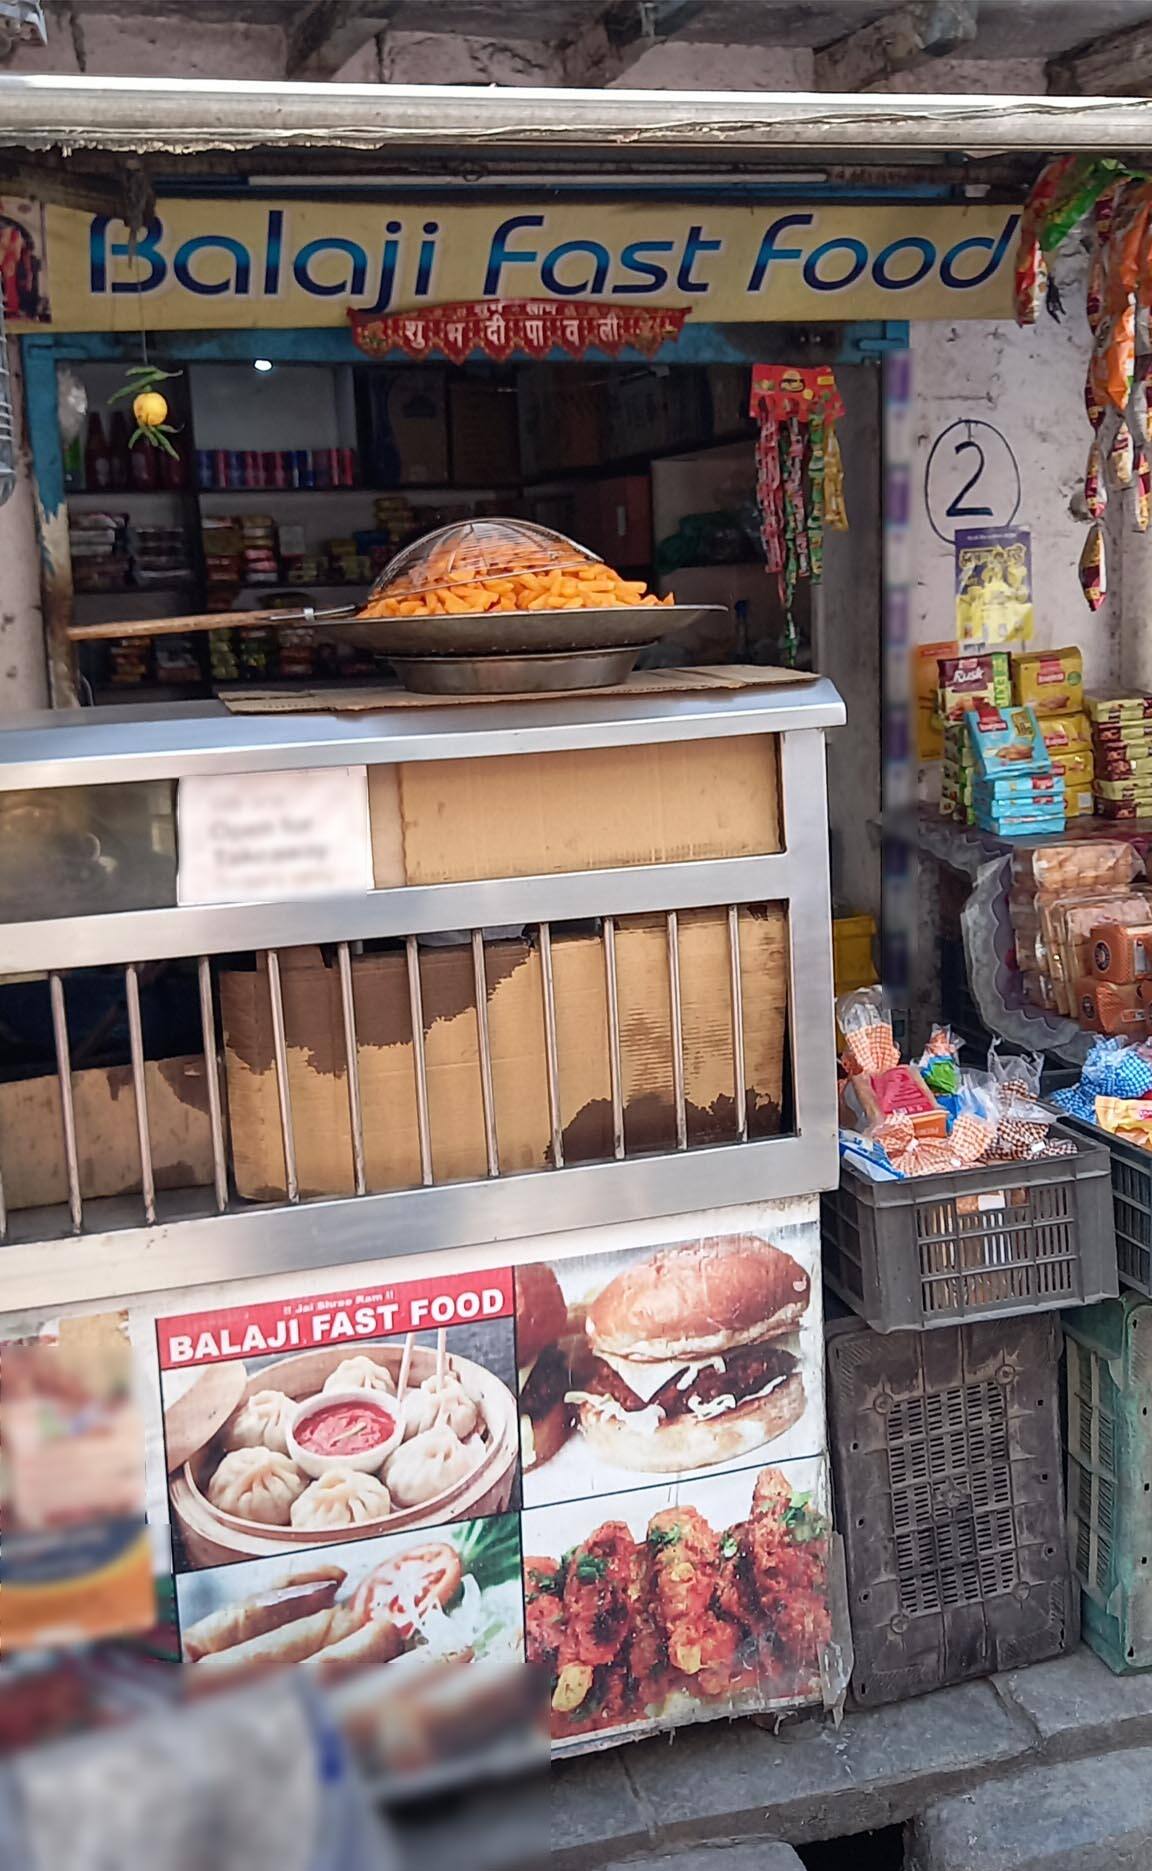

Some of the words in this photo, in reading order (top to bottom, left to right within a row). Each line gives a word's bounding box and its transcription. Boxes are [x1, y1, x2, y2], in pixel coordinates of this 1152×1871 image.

[90, 209, 441, 314] Balaji
[483, 214, 721, 296] Fast
[746, 213, 1022, 293] Food
[946, 441, 993, 516] 2
[169, 1318, 300, 1363] BALAJI
[312, 1304, 399, 1341] FAST
[411, 1289, 504, 1326] FOOD
